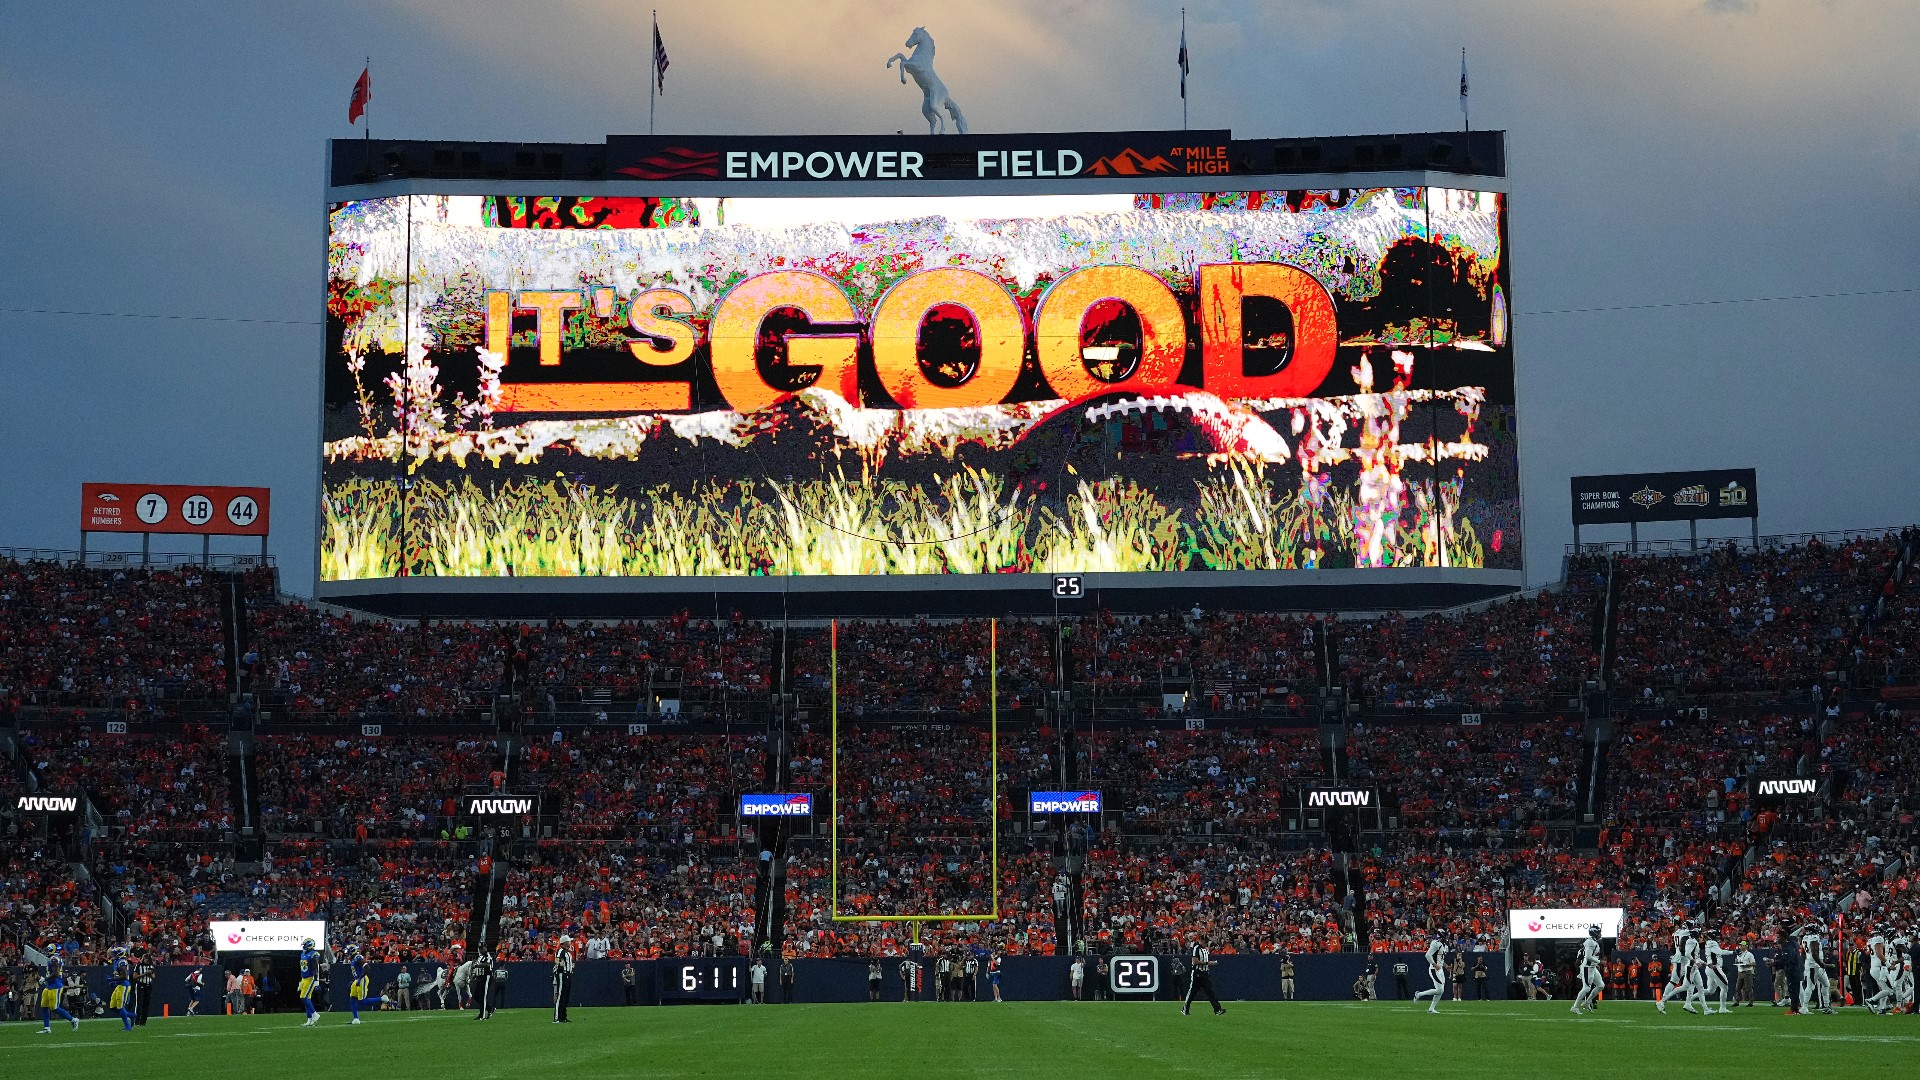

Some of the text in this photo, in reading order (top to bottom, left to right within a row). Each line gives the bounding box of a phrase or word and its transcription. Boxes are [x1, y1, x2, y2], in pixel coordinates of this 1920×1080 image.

[1170, 146, 1227, 160] AT MILE
[726, 150, 1083, 178] EMPOWER FIELD
[1186, 161, 1229, 174] HIGH
[485, 261, 1341, 413] IT'S GOOD
[1580, 491, 1621, 501] SUPER BOWL
[146, 500, 157, 518] 7
[187, 500, 208, 519] 18
[231, 502, 253, 520] 44
[1582, 500, 1620, 510] CHAMPIONS
[93, 507, 121, 516] RETIRED
[91, 516, 122, 525] NUMBERS
[106, 554, 123, 562] 229
[237, 556, 253, 565] 230
[1057, 577, 1080, 595] 25
[1187, 720, 1203, 729] 133
[1462, 715, 1479, 724] 134
[108, 723, 125, 733] 129
[363, 726, 380, 735] 130
[630, 725, 645, 734] 131
[1759, 780, 1817, 795] ARROW
[18, 797, 77, 811] ARROW
[1308, 791, 1370, 806] ARROW
[470, 799, 532, 815] ARROW
[743, 803, 810, 815] EMPOWER
[1033, 801, 1099, 812] EMPOWER
[1545, 922, 1575, 930] CHECK
[682, 965, 737, 991] 6:11
[1119, 962, 1151, 987] 25
